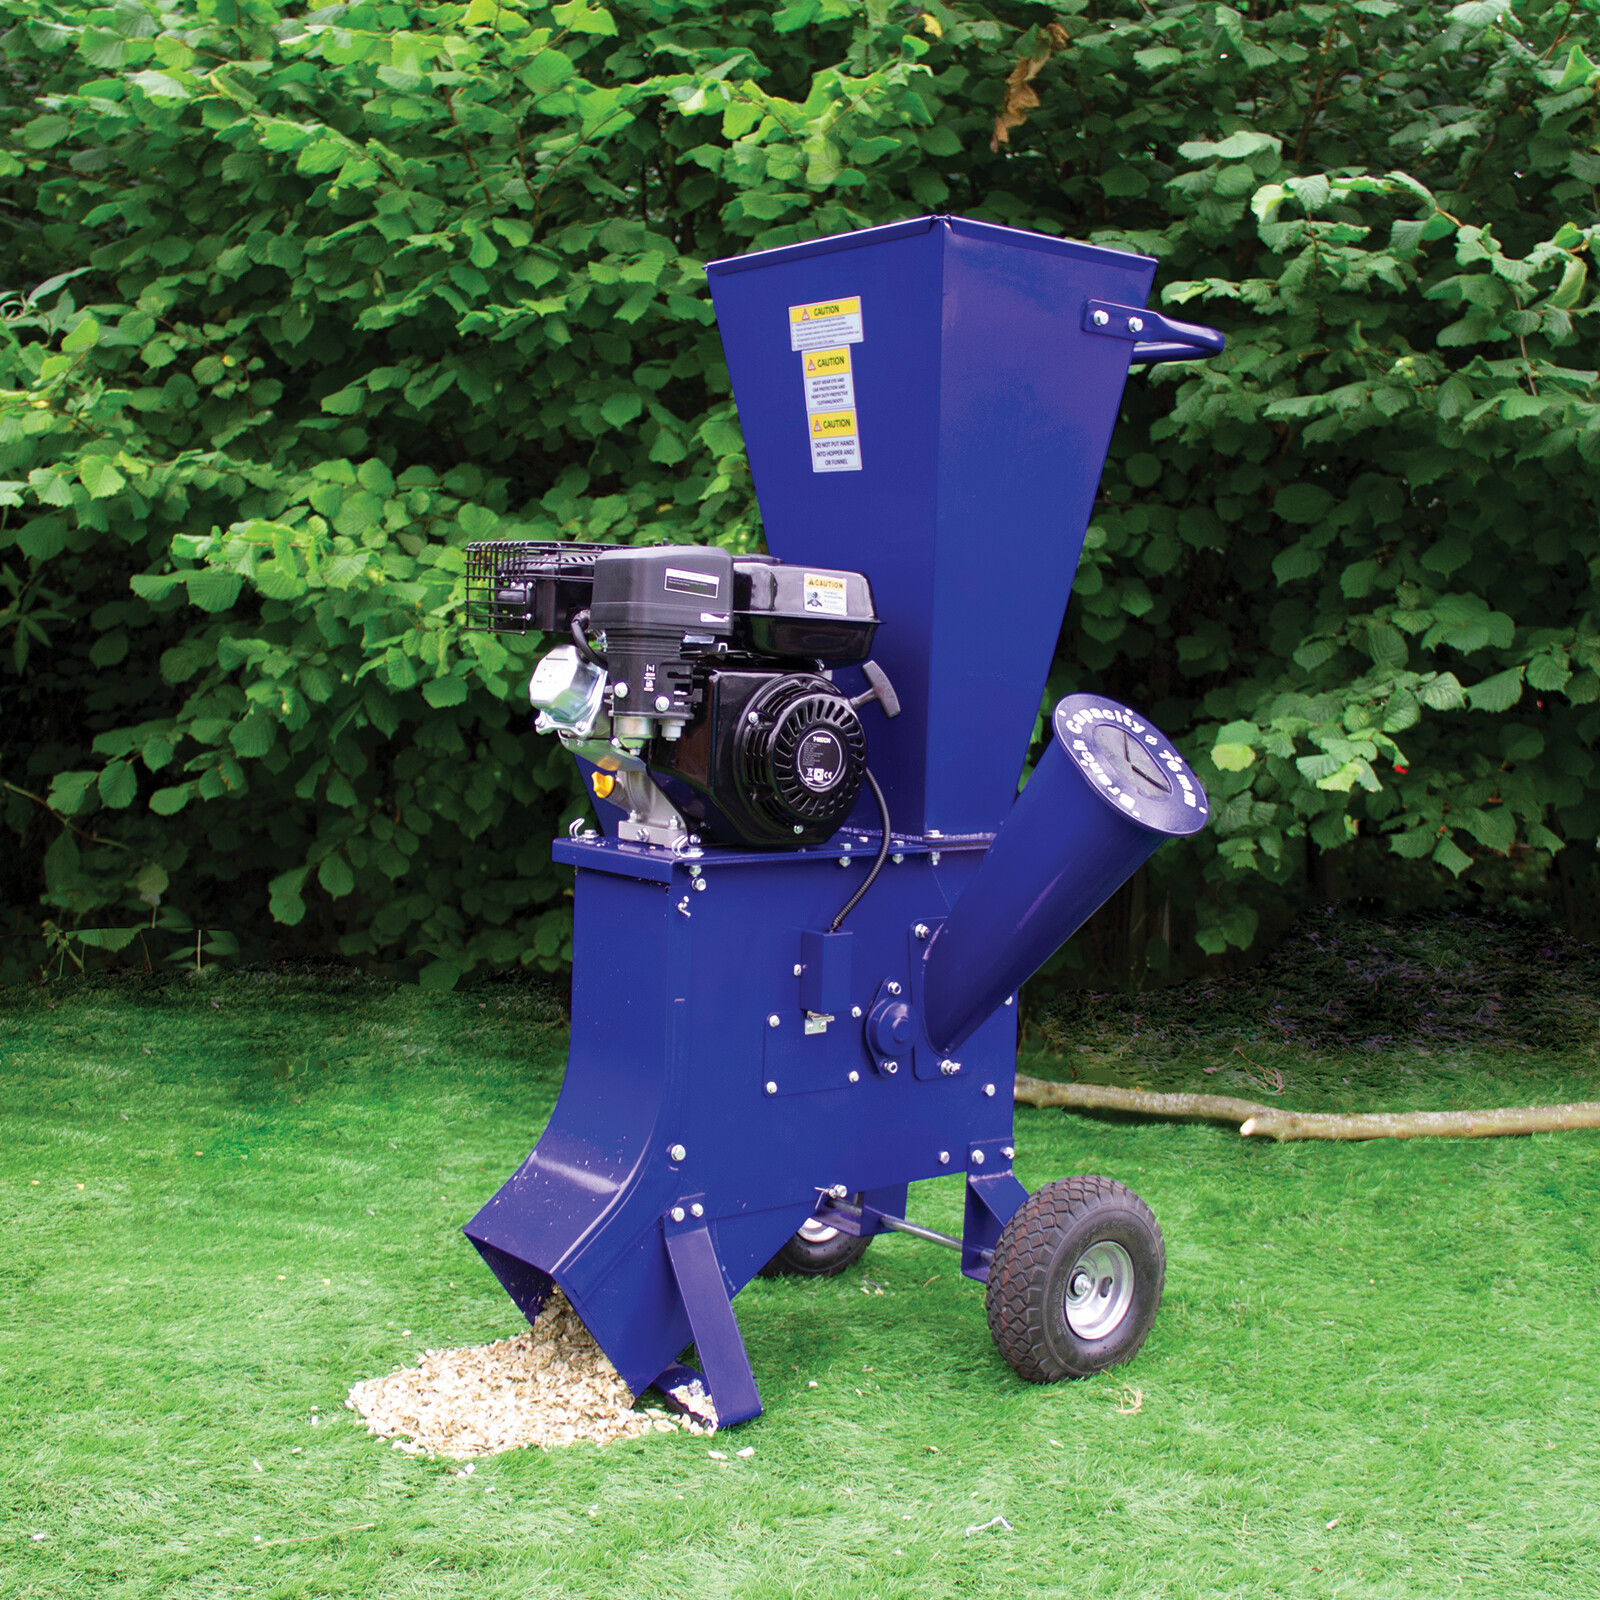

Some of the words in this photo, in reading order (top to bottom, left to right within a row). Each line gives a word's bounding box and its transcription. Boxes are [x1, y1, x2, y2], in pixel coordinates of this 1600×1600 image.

[814, 305, 839, 316] CAUTION
[817, 356, 844, 368] CAUTION
[823, 419, 851, 429] CAUTION
[815, 579, 843, 588] CAUTION
[1066, 708, 1145, 734] Capacity
[1072, 740, 1135, 809] Branch
